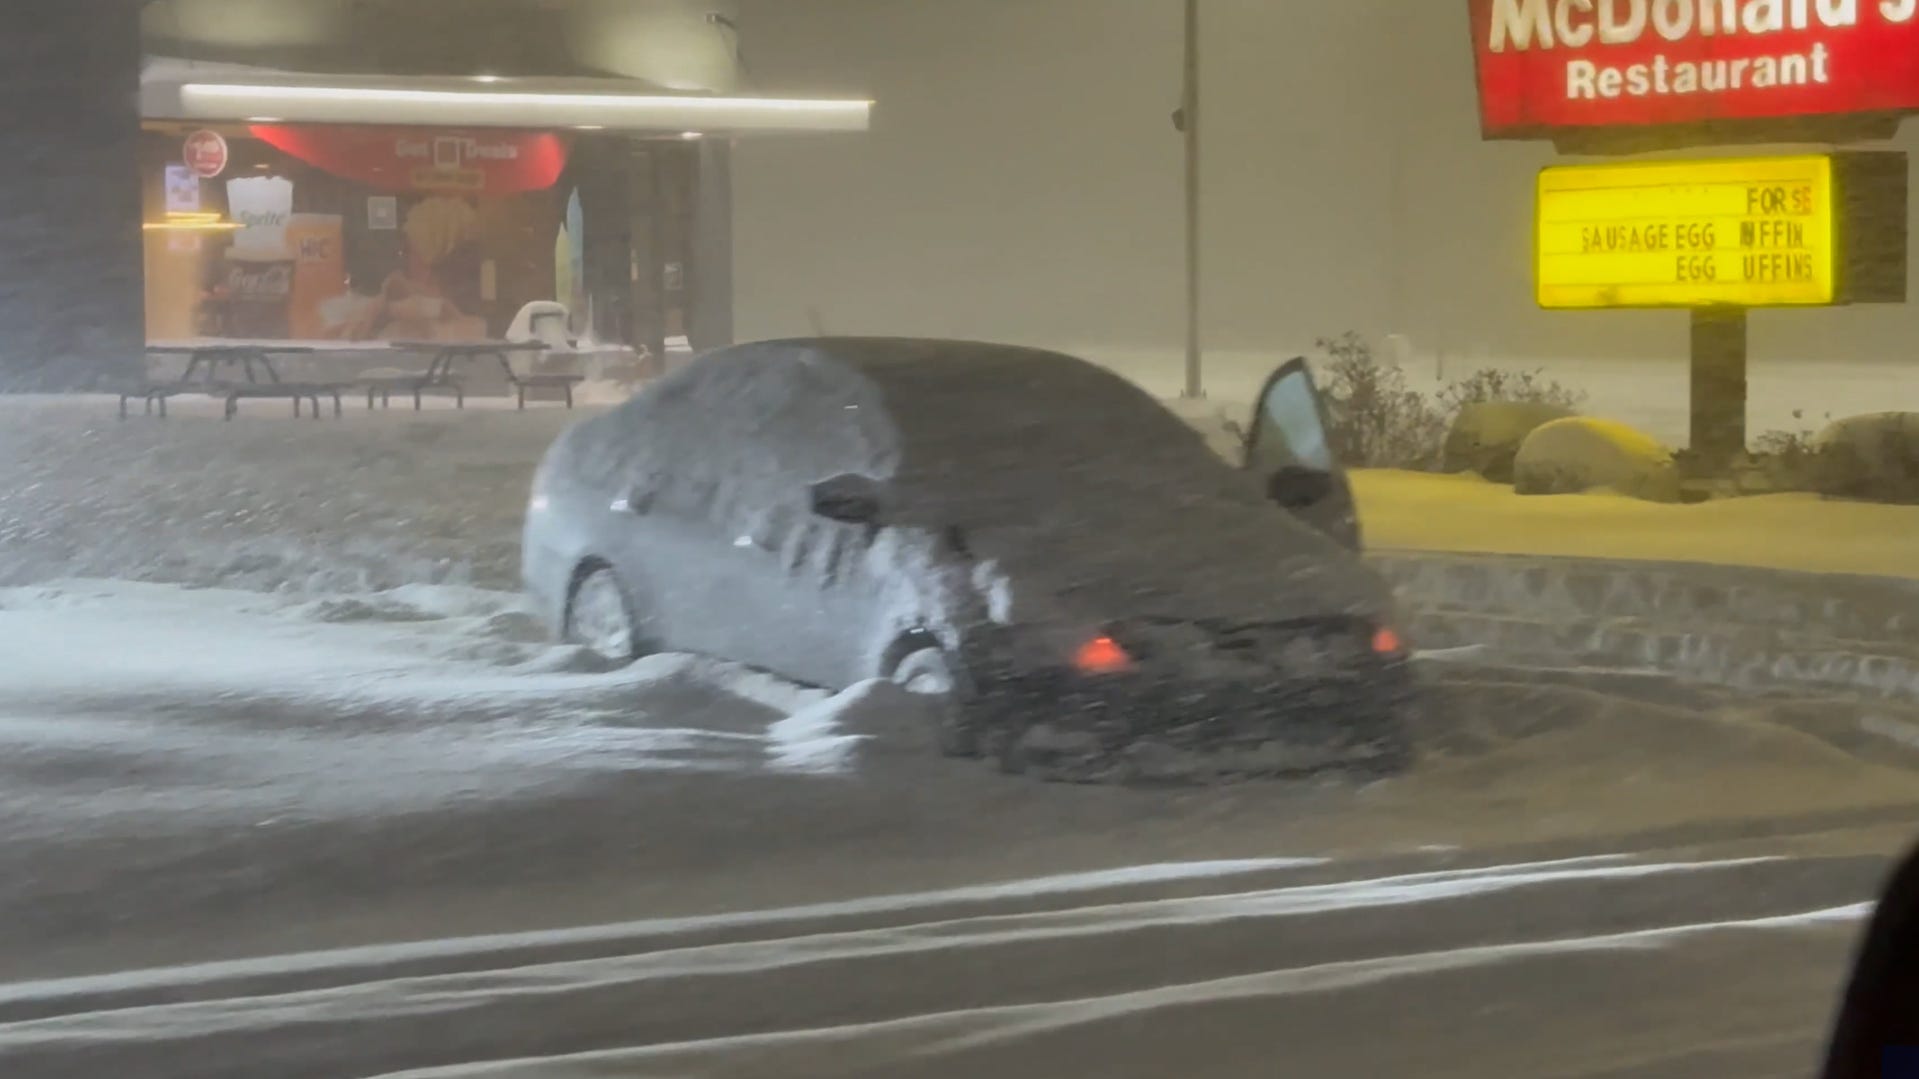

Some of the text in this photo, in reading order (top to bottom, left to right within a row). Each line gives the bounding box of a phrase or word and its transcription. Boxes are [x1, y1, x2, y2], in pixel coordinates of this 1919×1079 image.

[1489, 0, 1918, 52] McDonalds
[1566, 42, 1829, 99] Restaurant
[1746, 186, 1787, 215] FOR
[1582, 223, 1669, 253] SAUSAGE
[1675, 222, 1716, 250] EGG
[1675, 255, 1717, 281] EGG
